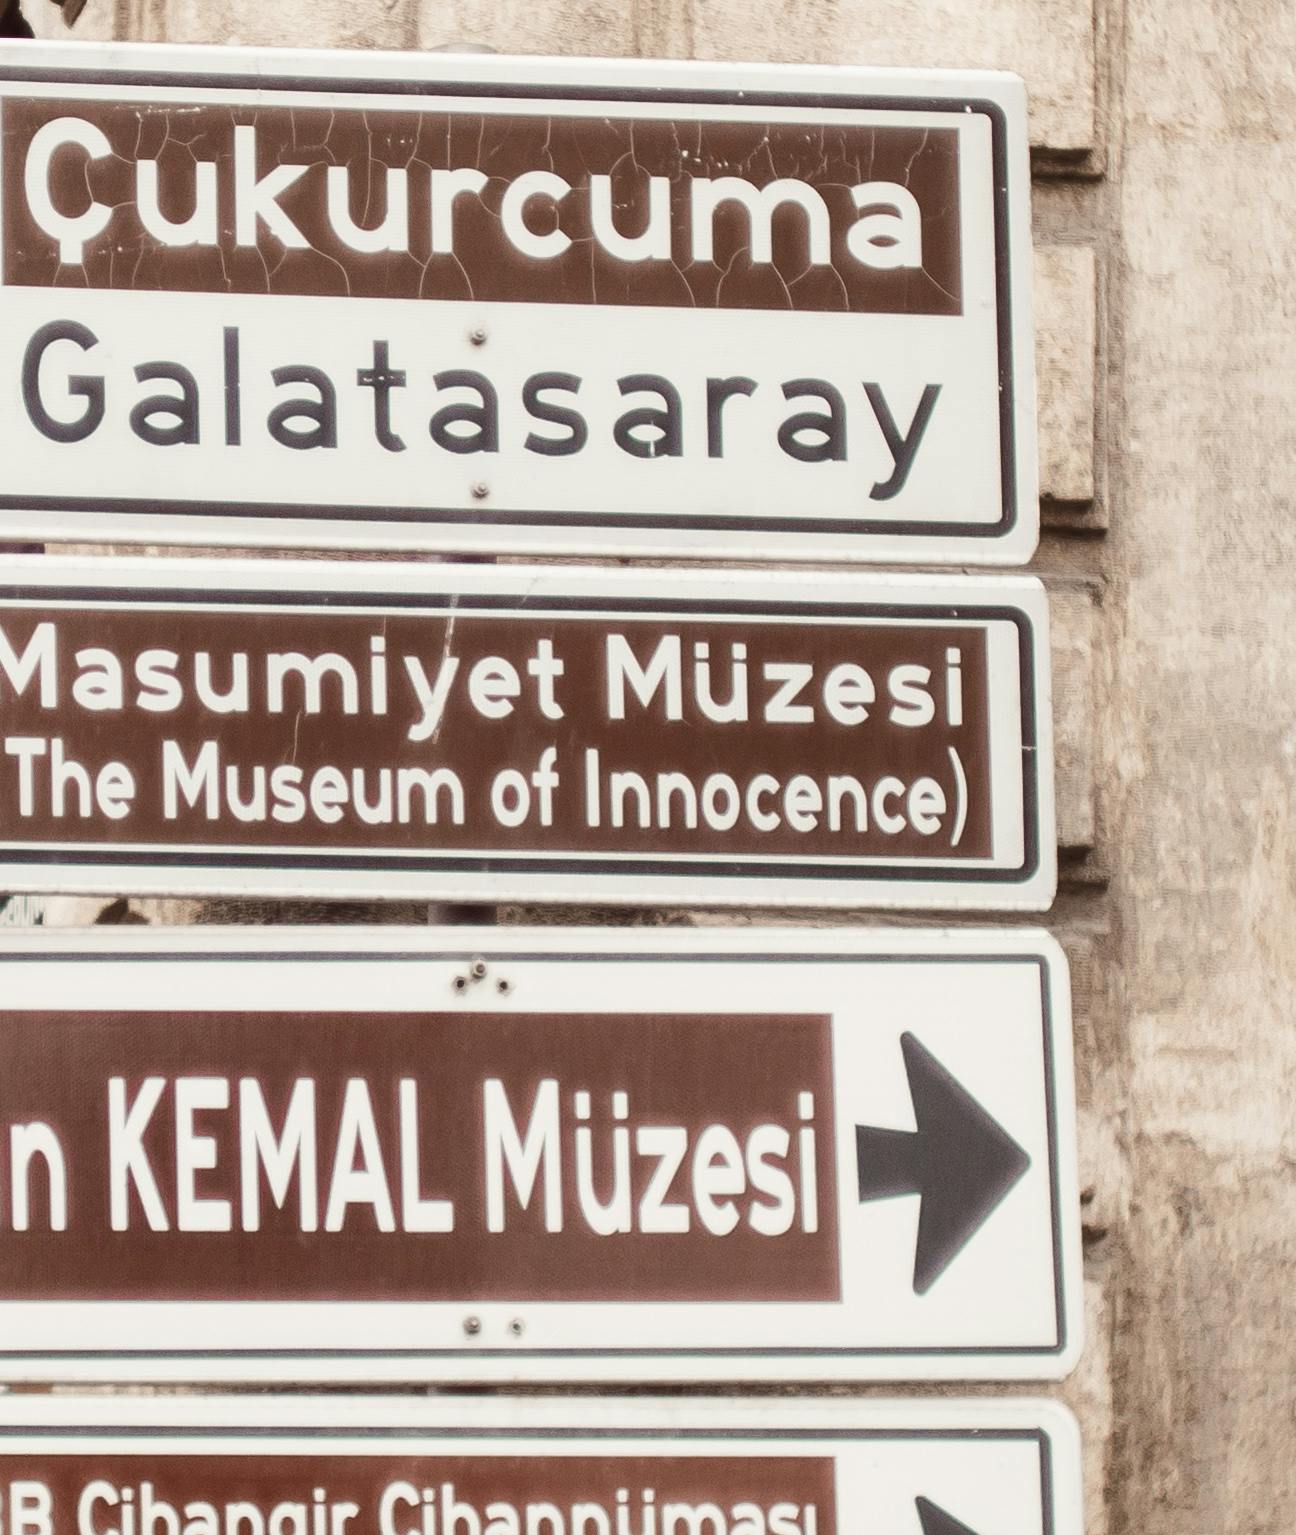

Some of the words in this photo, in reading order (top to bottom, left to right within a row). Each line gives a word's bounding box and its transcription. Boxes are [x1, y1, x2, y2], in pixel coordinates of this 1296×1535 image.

[24, 116, 924, 270] Çukurcuma
[23, 322, 940, 500] Galatasaray
[607, 634, 962, 726] Müzesi
[163, 741, 464, 824] Museum
[492, 747, 558, 826] of
[586, 747, 967, 845] Innocence)
[109, 1077, 453, 1232] KEMAL
[484, 1079, 817, 1236] Müzesi
